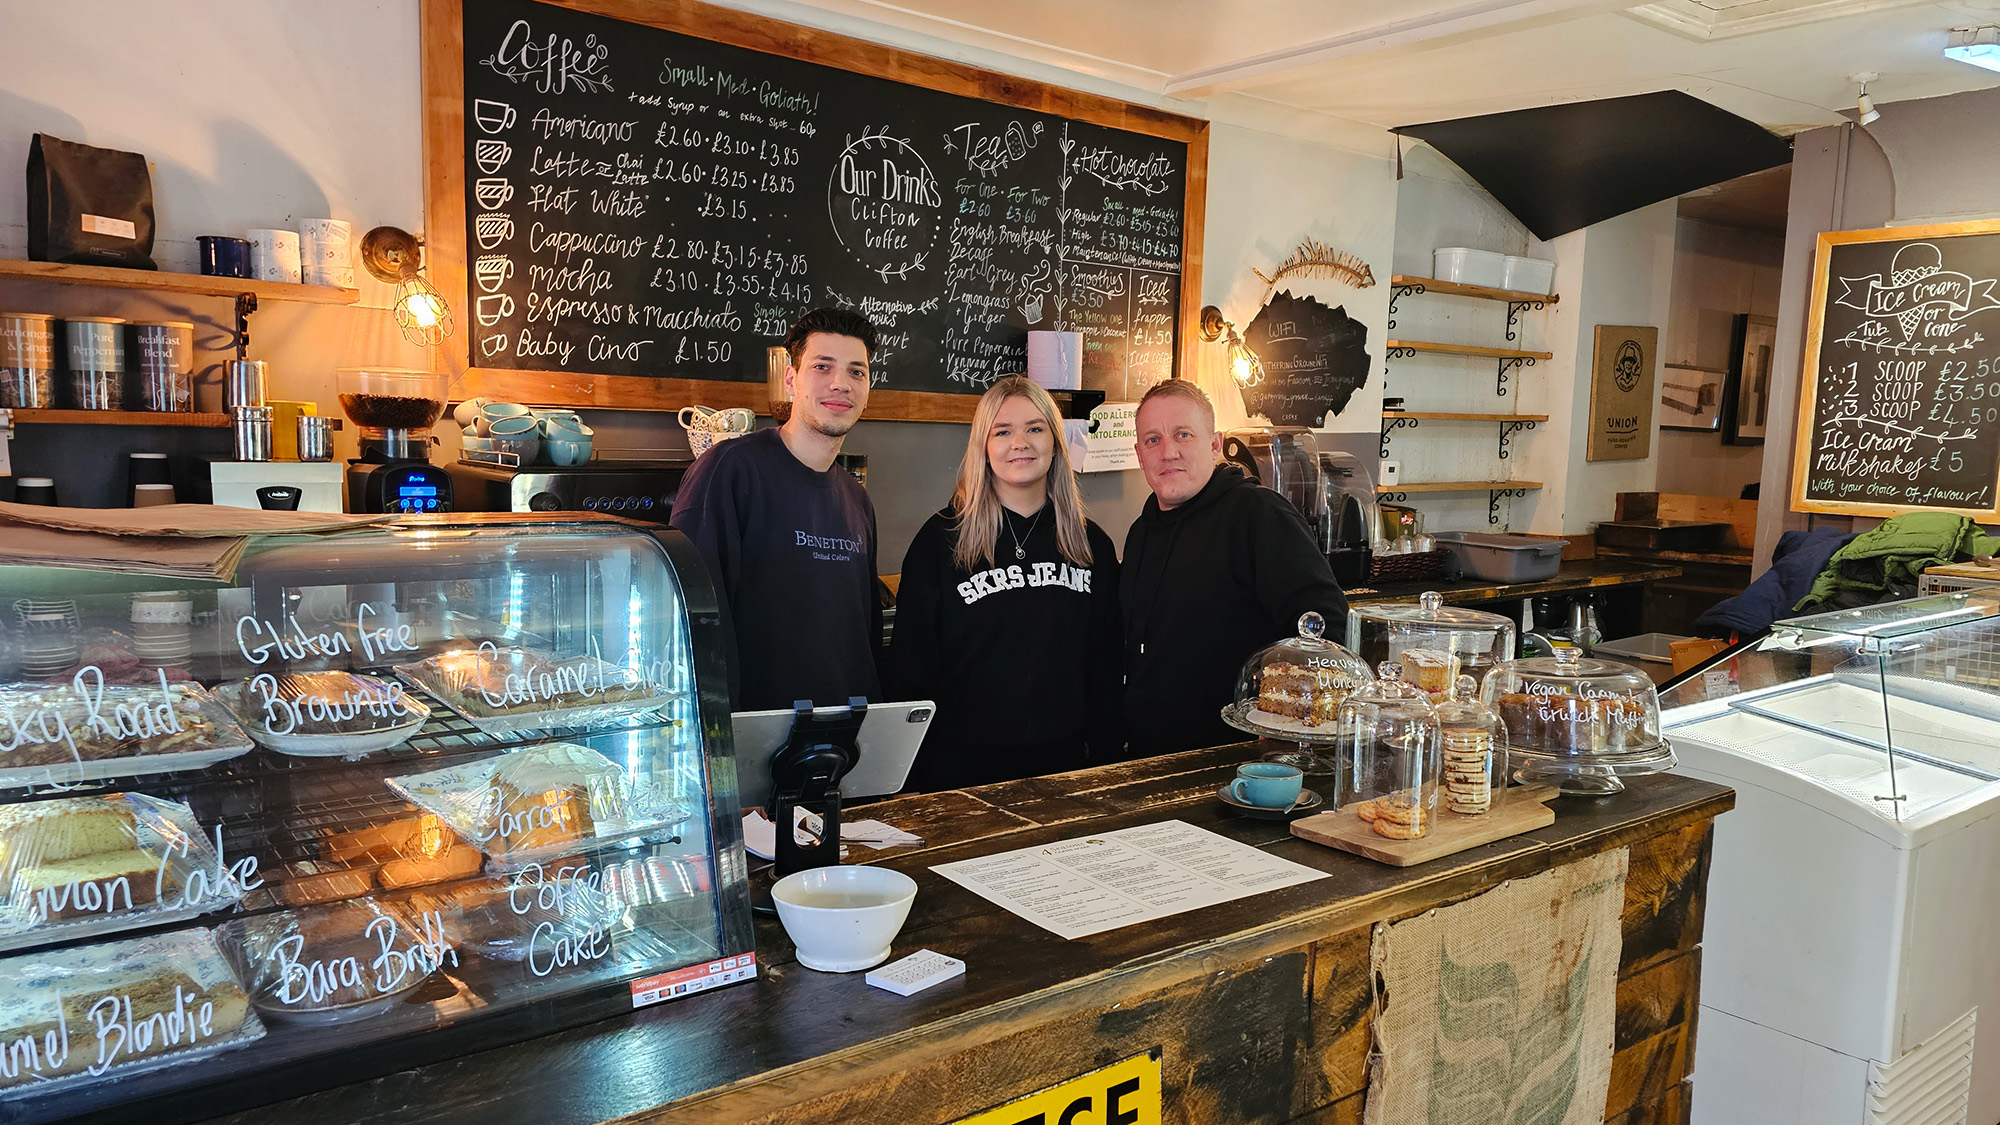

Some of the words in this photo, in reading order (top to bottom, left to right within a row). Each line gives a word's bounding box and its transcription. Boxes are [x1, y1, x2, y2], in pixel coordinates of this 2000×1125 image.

[498, 19, 610, 94] Coffee
[658, 57, 708, 87] Small
[717, 70, 750, 98] Med
[759, 80, 820, 116] Goliath!
[531, 107, 640, 145] Americano
[699, 104, 709, 113] or
[718, 108, 731, 119] an
[740, 112, 764, 124] extra
[799, 119, 817, 138] 60p
[654, 121, 702, 148] £2.60
[711, 131, 749, 155] £3.10
[759, 139, 799, 166] £3.85
[953, 122, 1007, 160] Tea
[529, 145, 595, 178] Latte
[616, 152, 644, 169] Chai
[652, 157, 701, 184] £2.60
[711, 164, 748, 189] £3.25
[760, 172, 795, 193] £3.85
[1080, 146, 1113, 173] Hot
[1110, 152, 1176, 181] Chocolate
[611, 169, 650, 185] Latte
[840, 154, 877, 196] Our
[881, 159, 942, 208] Drinks
[955, 177, 976, 194] For
[979, 181, 999, 199] One
[1006, 186, 1029, 204] For
[1030, 188, 1051, 206] Two
[527, 184, 579, 215] Flat
[590, 189, 646, 218] White
[701, 193, 747, 220] £3.15
[851, 196, 920, 227] Clifton
[959, 197, 991, 217] £2.60
[1006, 205, 1037, 223] £3.60
[1102, 196, 1124, 212] Small
[1071, 208, 1102, 228] Regular
[1102, 212, 1126, 227] £2.60
[529, 221, 648, 265] Cappuccino
[865, 228, 908, 250] Coffee
[950, 217, 998, 245] English
[998, 224, 1055, 255] Breakfast
[1070, 227, 1093, 245] High
[1100, 229, 1129, 251] £3.70
[1131, 236, 1152, 256] £4.15
[651, 234, 705, 260] £2.80
[712, 240, 757, 270] £3.15
[763, 249, 808, 278] £3.85
[949, 241, 994, 272] Decaff
[650, 267, 698, 293] £3.10
[713, 271, 760, 296] £3.55
[768, 277, 812, 304] £4.15
[946, 262, 977, 287] Earl
[986, 263, 1018, 294] Grey
[1070, 264, 1124, 293] Smoothies
[1137, 274, 1171, 298] Iced
[527, 291, 623, 326] Espresso
[628, 303, 640, 325] &
[643, 300, 742, 332] Macchiato
[753, 301, 787, 320] Single
[860, 296, 916, 315] Alternative
[948, 281, 1010, 315] Lemongrass
[1071, 287, 1104, 308] £3.50
[1872, 290, 1906, 313] Ice
[1912, 280, 1967, 303] Cream
[963, 303, 1006, 335] Ginger
[1069, 308, 1083, 325] The
[1084, 309, 1108, 324] Yellow
[1109, 314, 1123, 325] one
[1268, 321, 1297, 338] WIFI
[1857, 319, 1890, 337] Tub
[1923, 307, 1946, 321] or
[7, 341, 16, 351] &
[73, 345, 125, 358] Peppermin
[90, 332, 114, 343] Pure
[137, 334, 181, 346] Breakfast
[516, 328, 576, 366] Baby
[588, 334, 654, 362] Cino
[674, 336, 732, 364] £1.50
[945, 327, 969, 352] Pure
[1134, 327, 1172, 347] £4.50
[144, 349, 173, 359] Blend
[946, 352, 991, 373] Yunnan
[993, 355, 1024, 377] Green
[1129, 350, 1150, 368] Iced
[1846, 361, 1859, 381] 1
[1874, 360, 1927, 383] SCOOP
[1938, 357, 2000, 382] £2.50
[1844, 380, 1860, 398] 2
[1872, 381, 1924, 402] SCOOP
[1933, 382, 2000, 402] £3.50
[1607, 415, 1638, 429] UNION
[1844, 400, 1859, 416] 3
[1869, 400, 1922, 421] SCOOP
[1928, 403, 1998, 428] £4.50
[1090, 429, 1137, 440] INTOLERANC
[1818, 428, 1854, 452] Ice
[1857, 431, 1914, 453] Cream
[1840, 481, 1865, 500] your
[1866, 482, 1901, 497] choice
[1905, 489, 1921, 504] of
[1922, 485, 1988, 506] flavour!
[794, 530, 860, 553] BENETTON
[956, 564, 1027, 605] SKRS
[1026, 562, 1092, 594] JEANS
[236, 615, 352, 665] Gluten
[476, 633, 607, 709] Caramel
[73, 665, 186, 742] Road
[250, 673, 410, 737] Brownie
[1524, 679, 1572, 705] Vegan
[474, 786, 573, 844] Carrot
[155, 823, 265, 912] Cake
[270, 934, 363, 1005] Bara
[364, 911, 460, 994] Brith
[529, 921, 610, 977] Cake
[86, 984, 214, 1077] Blondie
